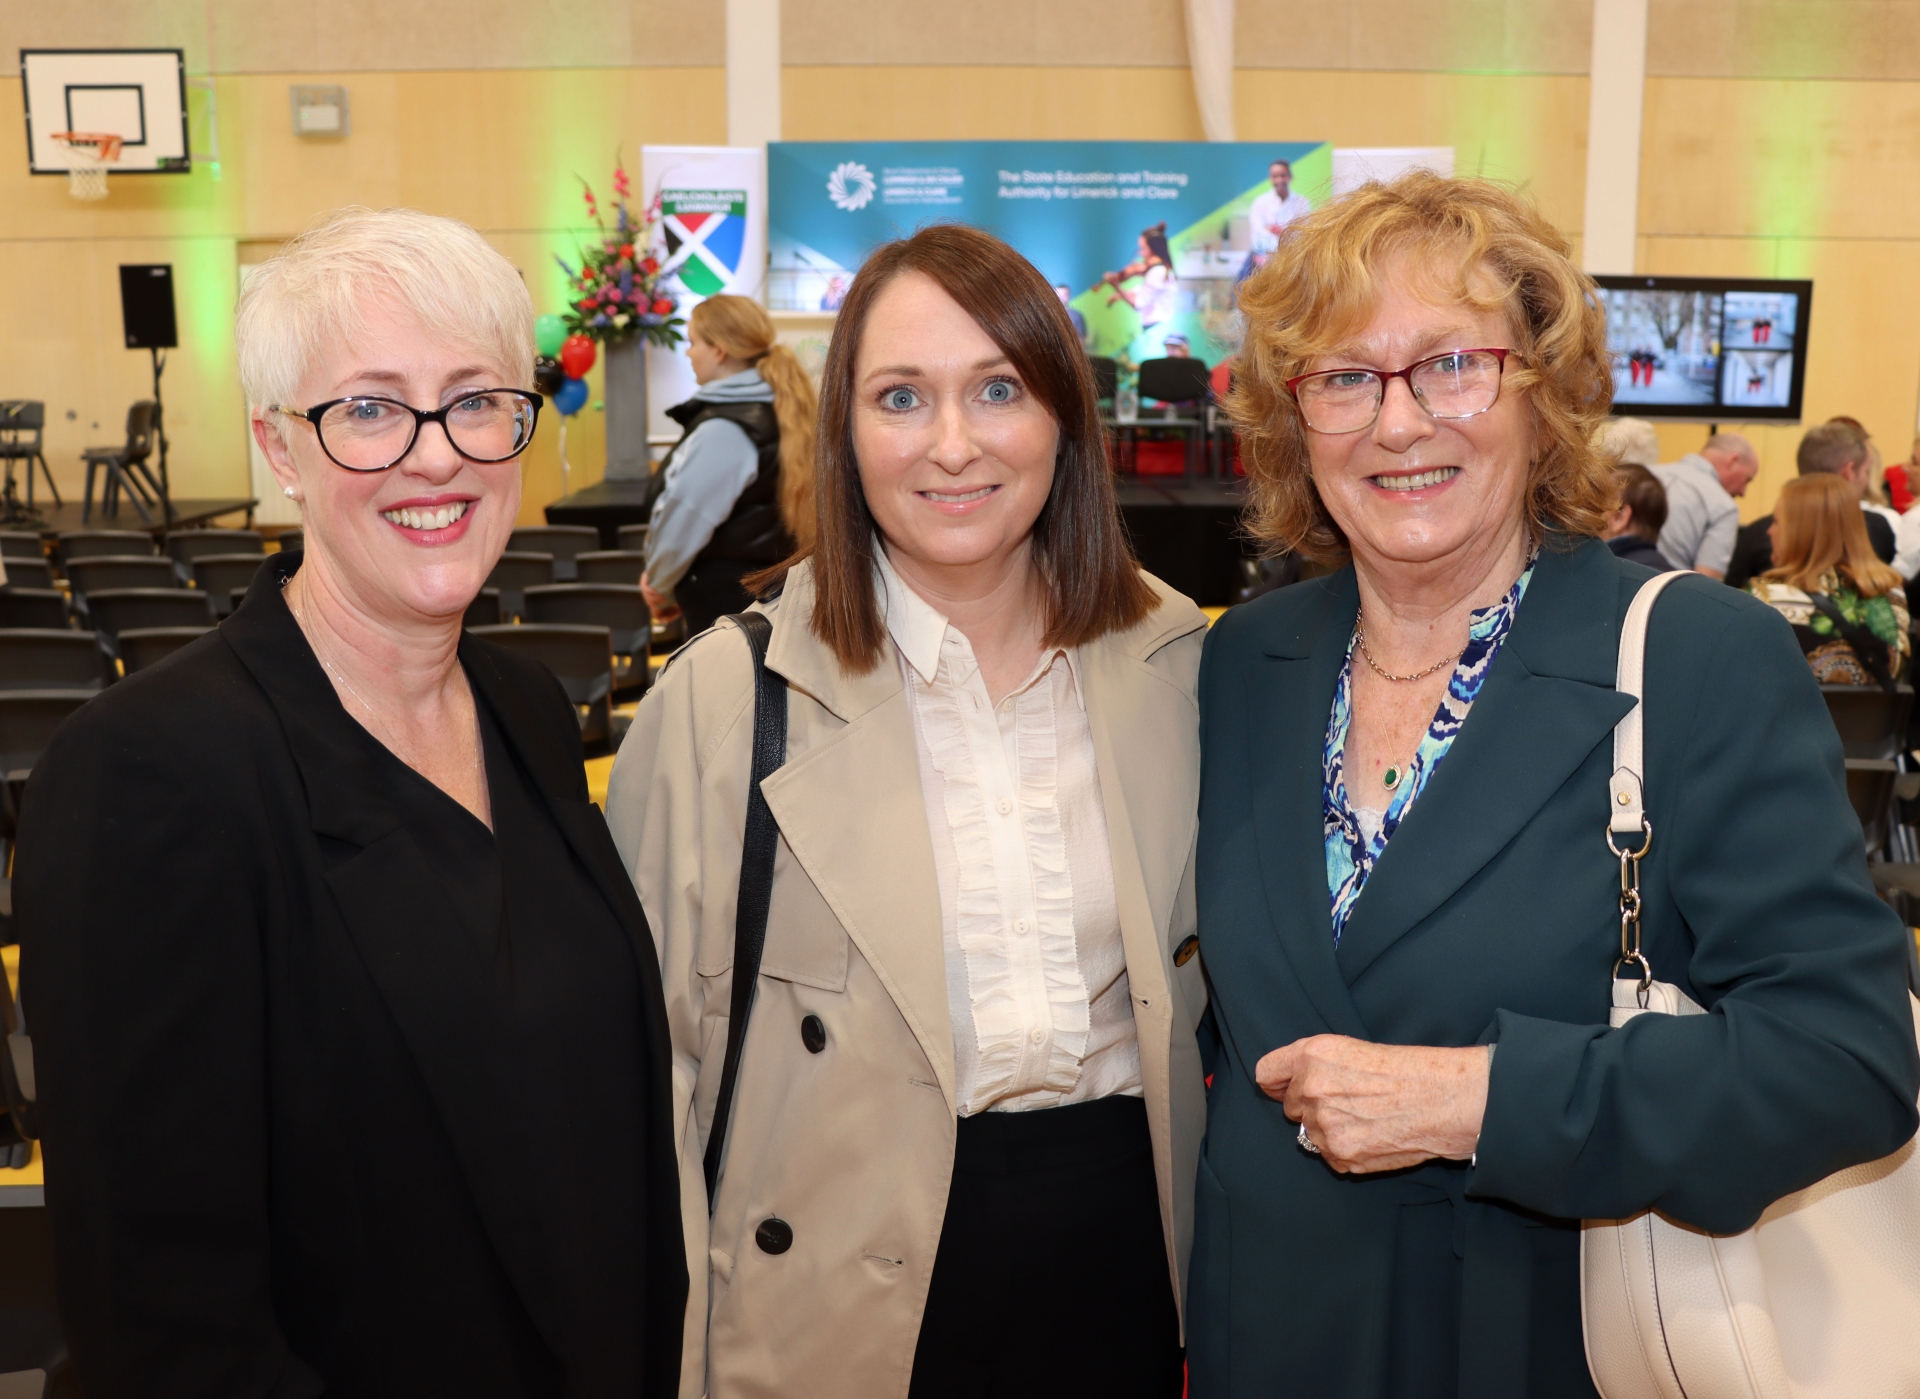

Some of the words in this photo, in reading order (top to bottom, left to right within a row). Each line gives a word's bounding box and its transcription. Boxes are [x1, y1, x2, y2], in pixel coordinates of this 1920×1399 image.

[998, 170, 1020, 183] The
[1022, 170, 1053, 183] State
[1055, 170, 1115, 183] Education
[1118, 172, 1140, 183] and
[1142, 170, 1188, 187] Training
[998, 186, 1051, 201] Authority
[1053, 186, 1069, 199] for
[1071, 186, 1118, 199] Limerick
[1120, 187, 1144, 199] and
[1146, 186, 1178, 199] Clare
